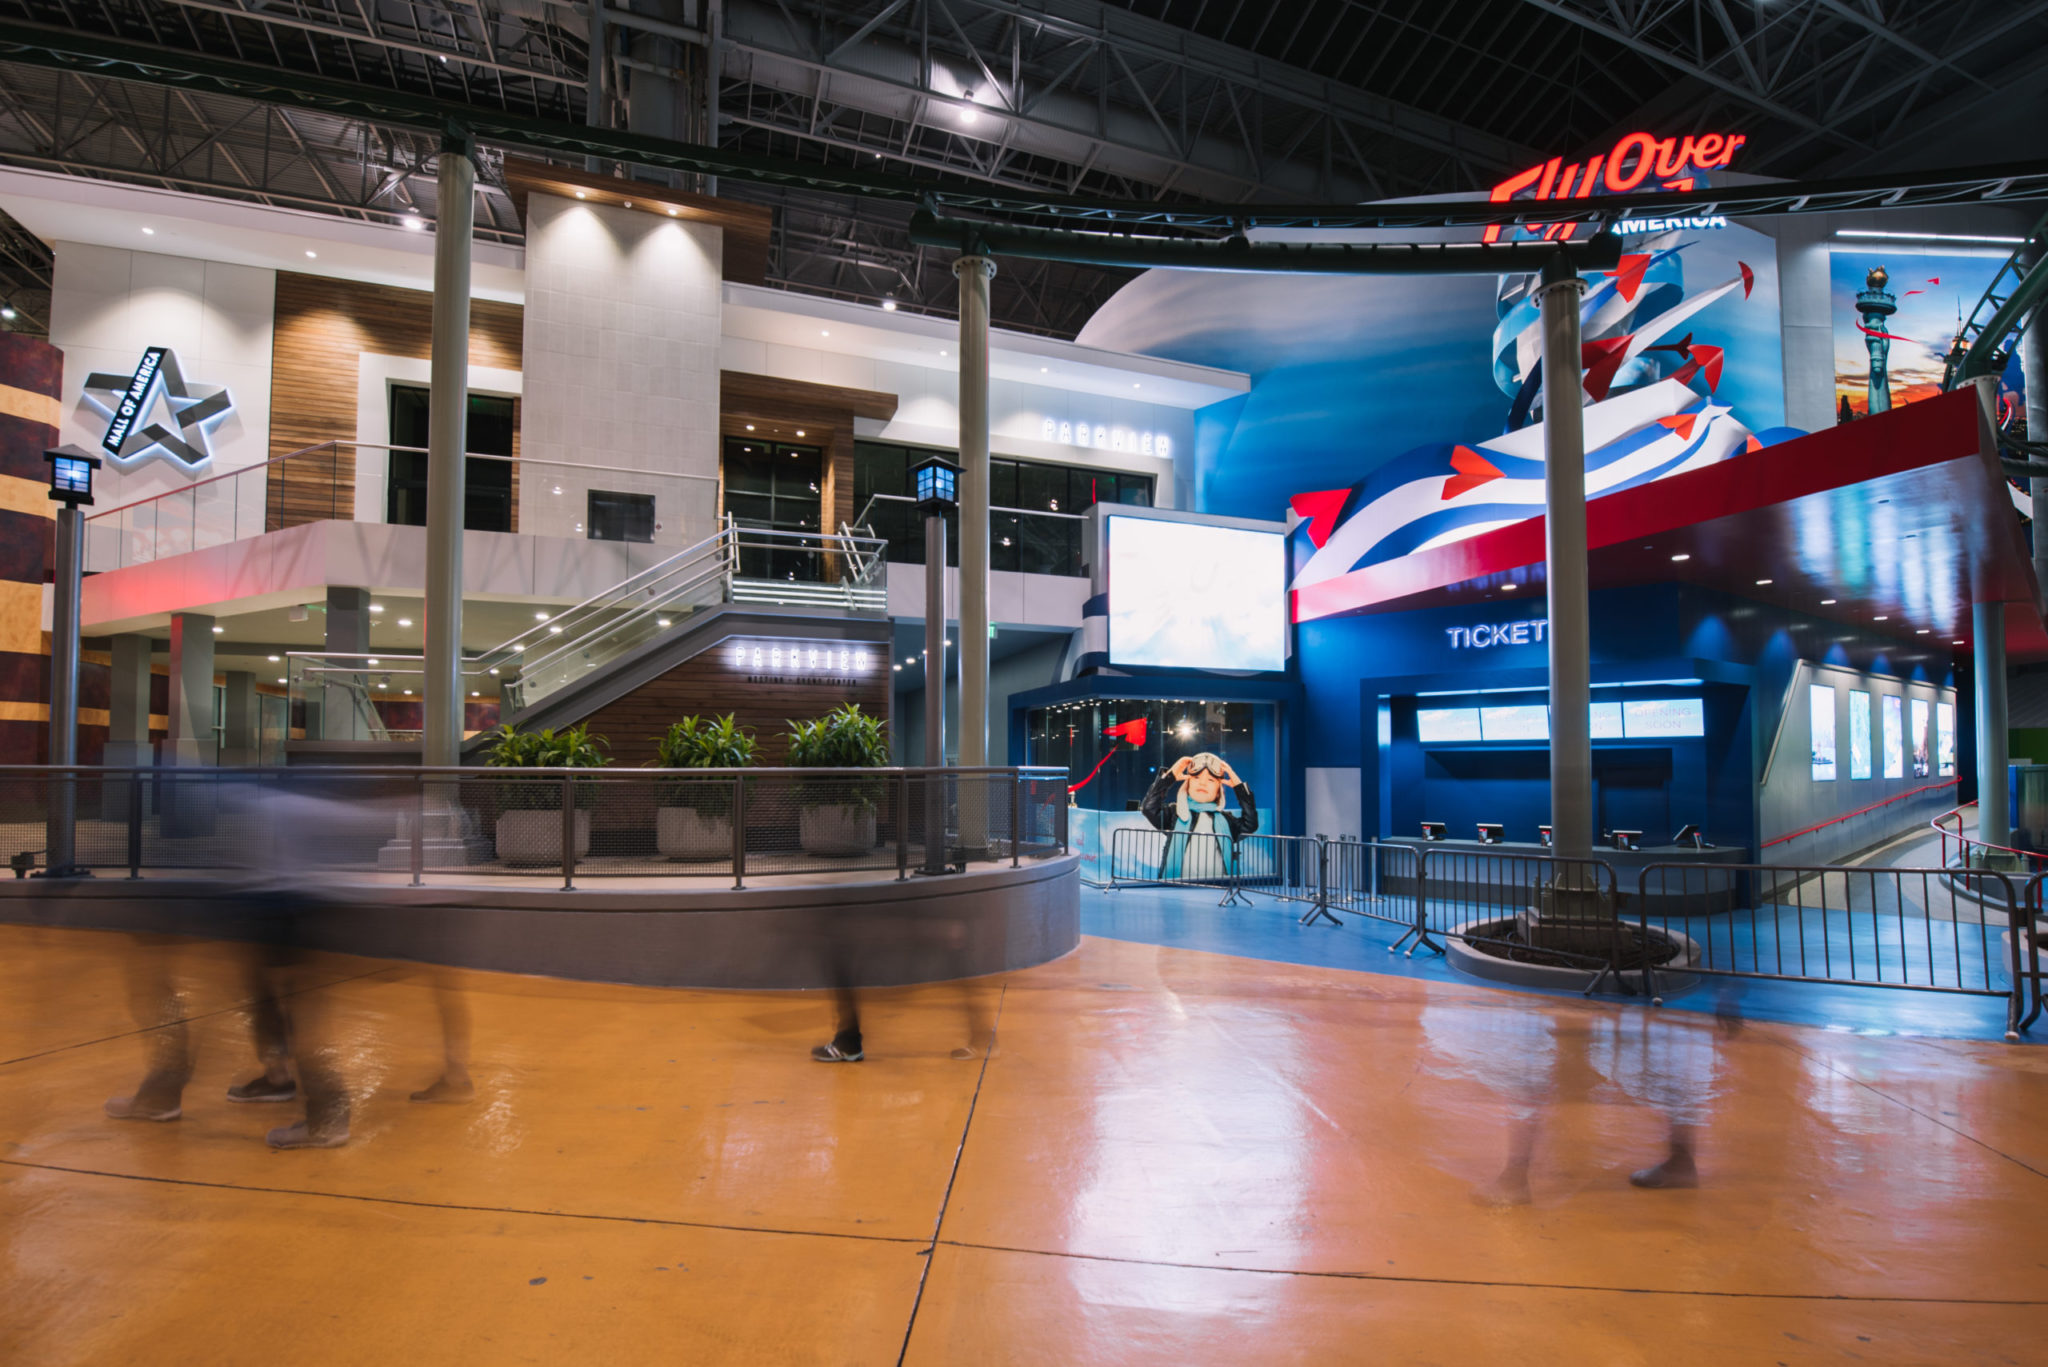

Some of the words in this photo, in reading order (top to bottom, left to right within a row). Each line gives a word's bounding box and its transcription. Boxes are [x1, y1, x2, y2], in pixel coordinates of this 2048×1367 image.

[107, 418, 129, 447] MALL
[121, 398, 137, 417] OF
[129, 352, 161, 400] AMERICA
[1042, 418, 1170, 458] PARKVIEW
[1445, 619, 1548, 649] TICKET
[735, 646, 868, 671] PARKVIEW
